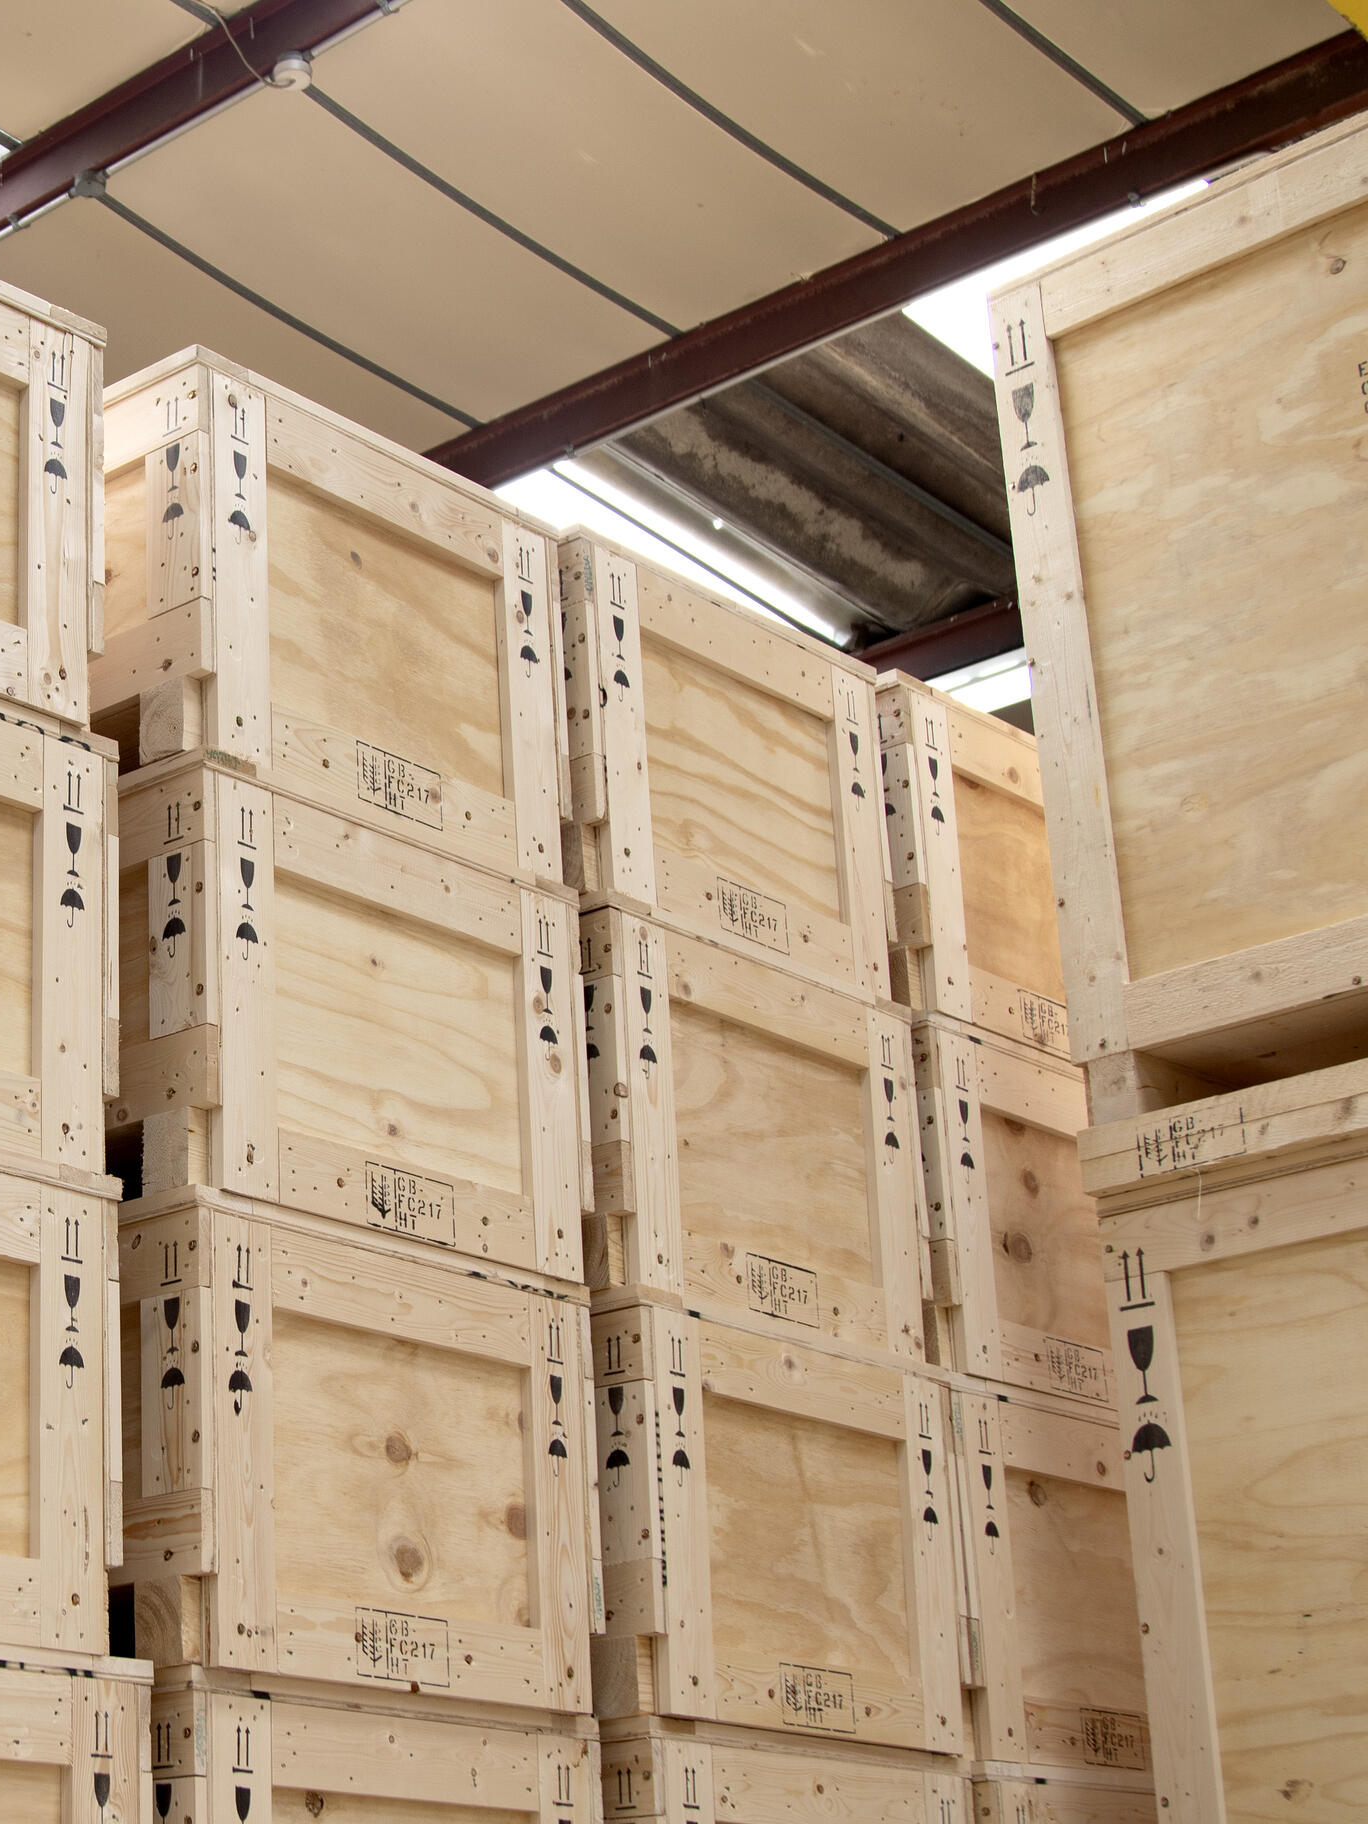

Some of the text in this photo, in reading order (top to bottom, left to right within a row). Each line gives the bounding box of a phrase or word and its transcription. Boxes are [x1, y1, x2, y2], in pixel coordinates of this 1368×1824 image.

[388, 775, 429, 803] FC217
[389, 792, 405, 810] HT
[743, 907, 777, 931] FC217
[745, 921, 758, 938] HT
[399, 1194, 441, 1219] FC217
[399, 1211, 417, 1230] HT
[773, 1282, 807, 1304] FC217
[774, 1298, 788, 1314] HT
[1069, 1362, 1097, 1380] FC217
[390, 1638, 435, 1660] FC217
[391, 1657, 409, 1675] HT
[807, 1690, 842, 1709] FC217
